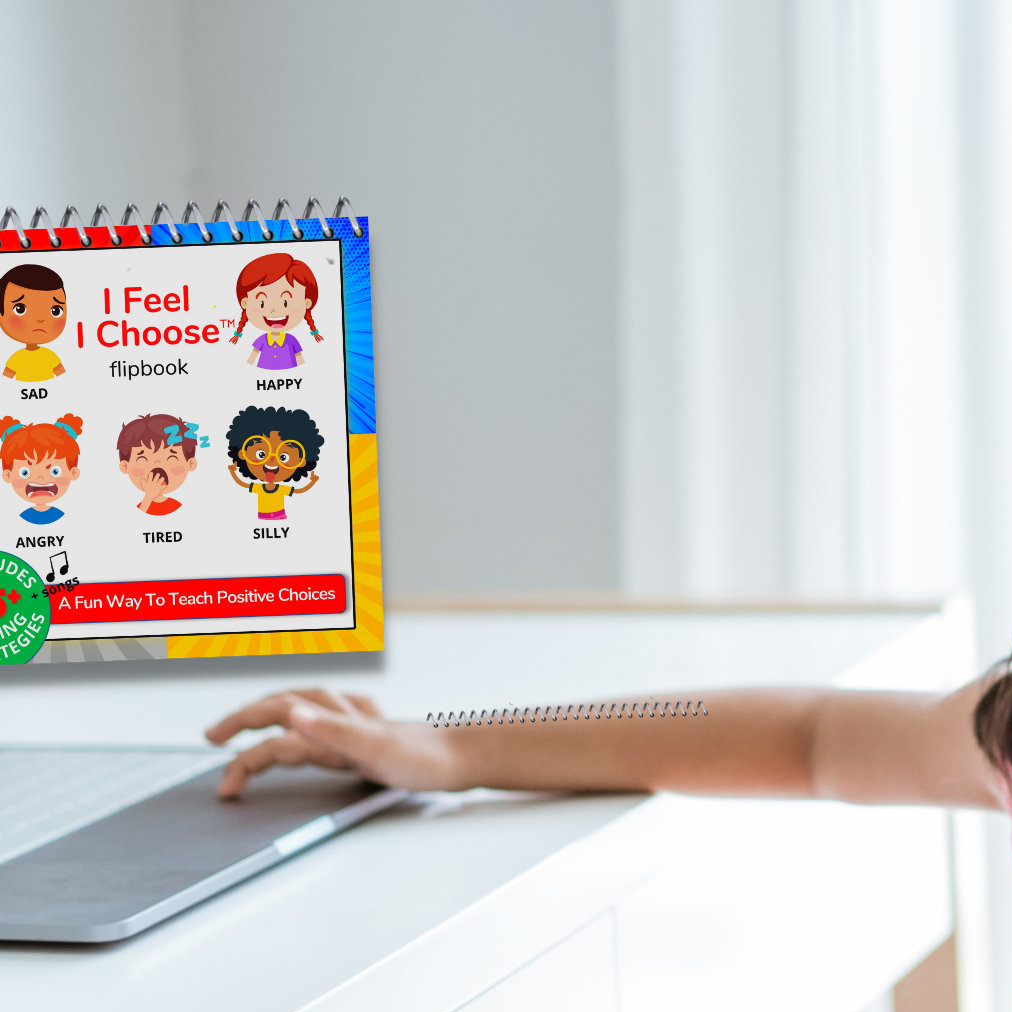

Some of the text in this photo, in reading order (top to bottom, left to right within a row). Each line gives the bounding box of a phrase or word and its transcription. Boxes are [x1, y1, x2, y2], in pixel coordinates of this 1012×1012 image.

[103, 284, 190, 315] I Feel
[76, 321, 84, 349] I
[109, 358, 189, 381] flipbook
[256, 377, 303, 392] HAPPY
[20, 387, 49, 401] SAD
[15, 535, 65, 549] ANGRY
[142, 531, 183, 544] TIRED
[253, 526, 290, 541] SILLY
[41, 576, 81, 598] songs
[58, 586, 336, 611] A Fun Way To Teach Positive Choices
